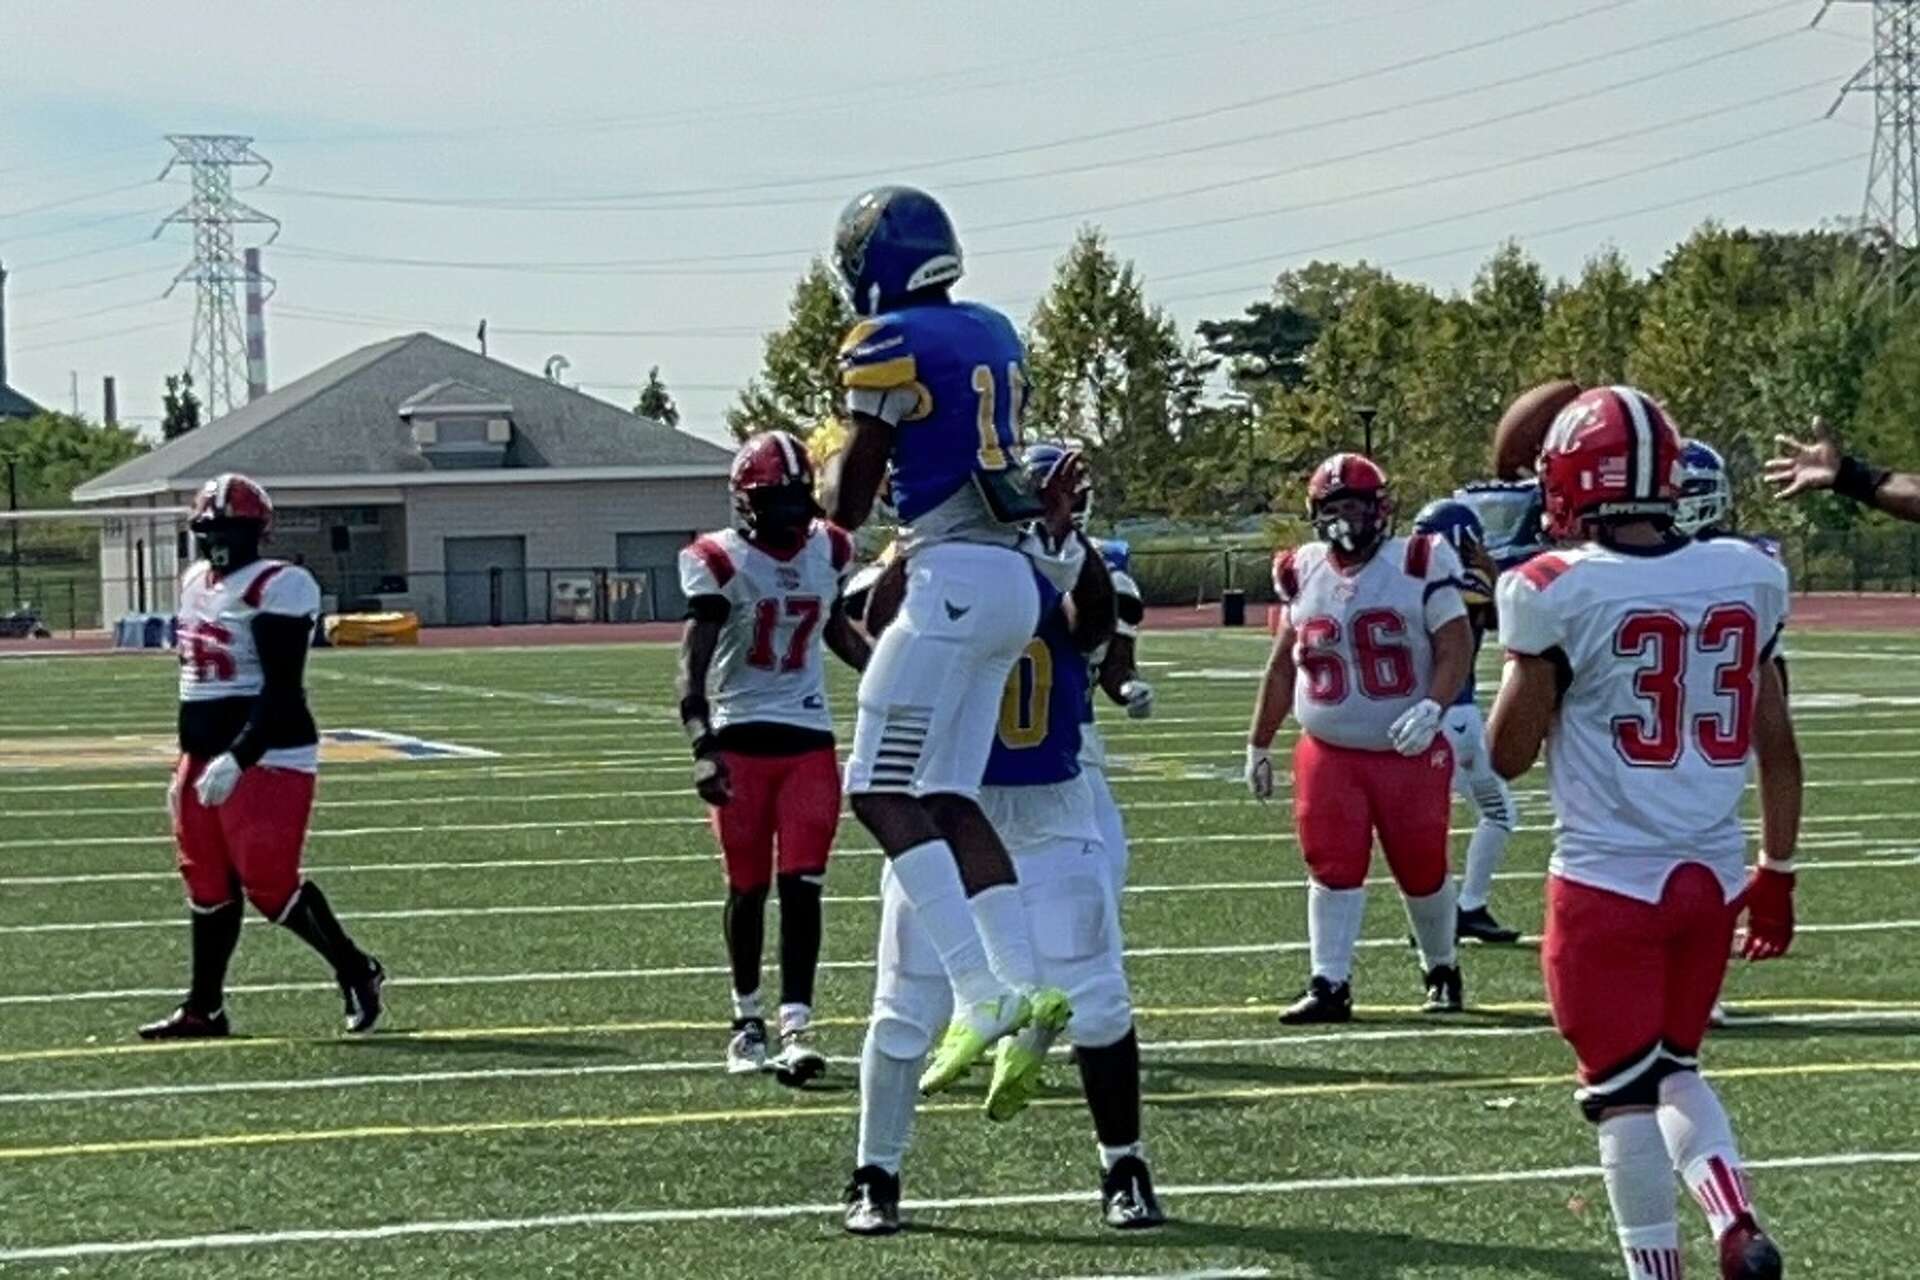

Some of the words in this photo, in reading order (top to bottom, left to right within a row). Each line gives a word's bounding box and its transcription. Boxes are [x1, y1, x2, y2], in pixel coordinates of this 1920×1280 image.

[745, 594, 822, 673] 17
[1299, 607, 1417, 705] 66
[1610, 601, 1758, 769] 33
